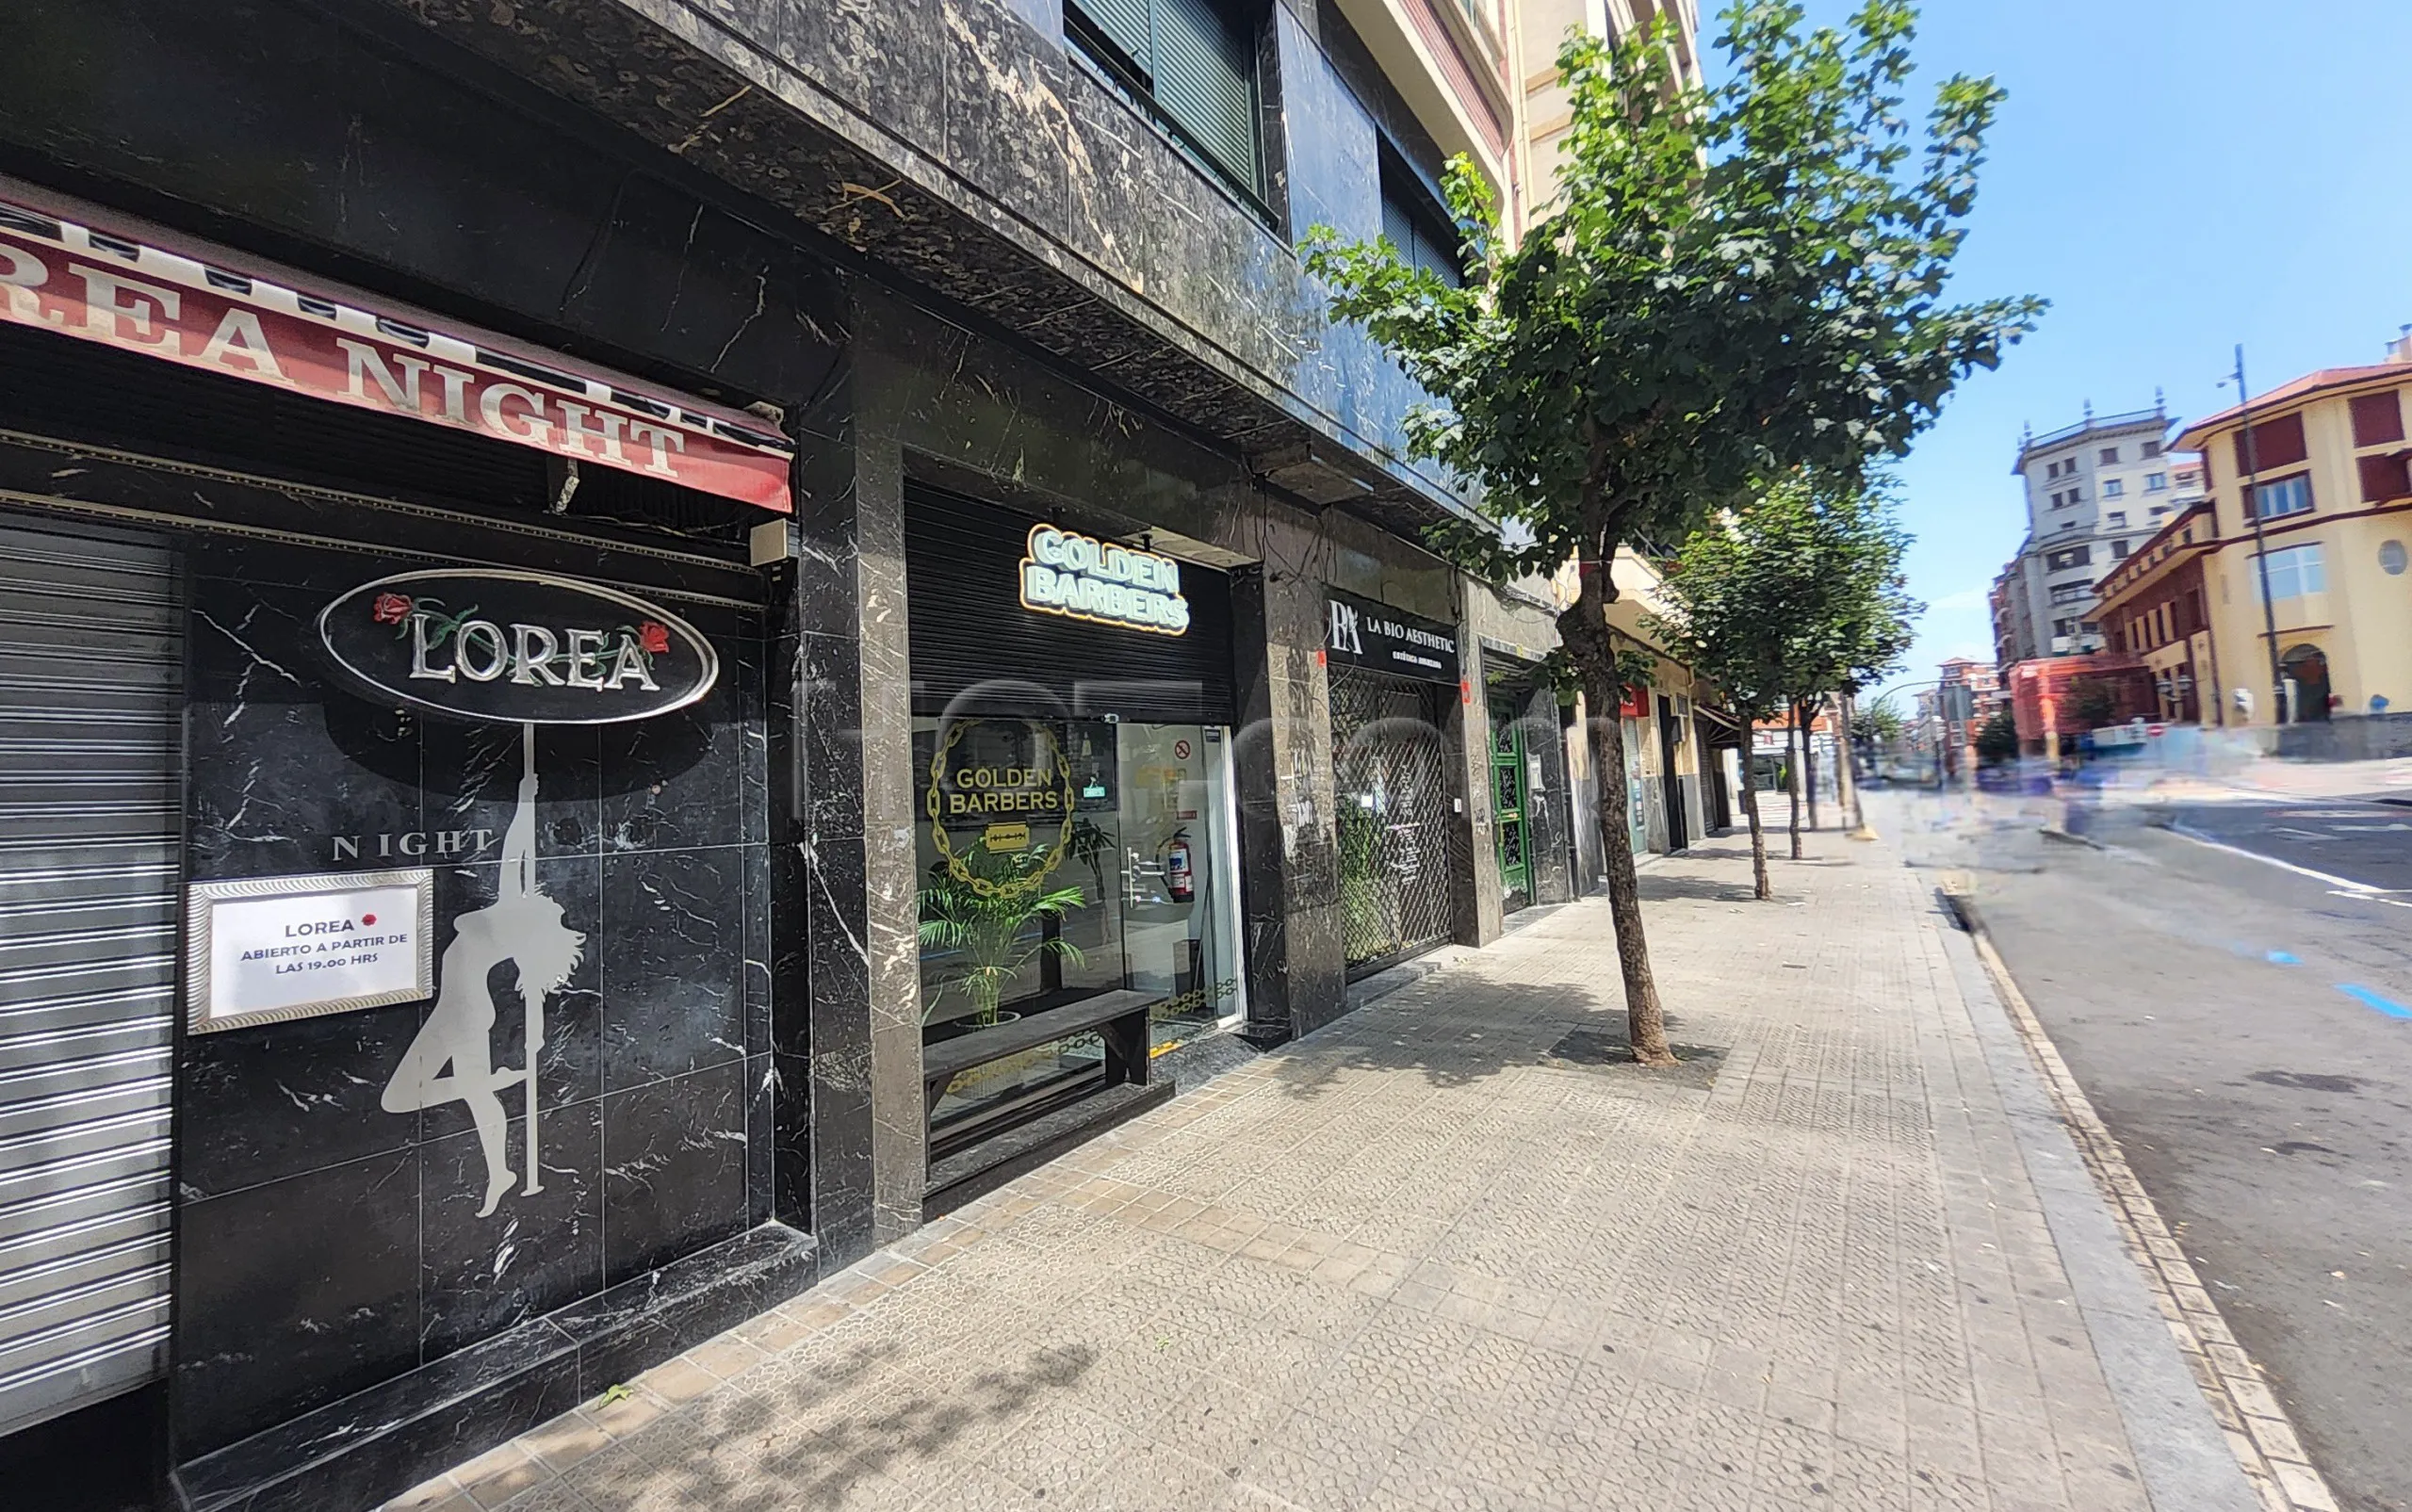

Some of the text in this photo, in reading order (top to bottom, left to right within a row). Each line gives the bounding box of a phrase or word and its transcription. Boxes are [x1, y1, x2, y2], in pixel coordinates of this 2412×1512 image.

[336, 337, 685, 478] NIGHT
[1035, 530, 1180, 593] GOLDEN
[1026, 565, 1190, 627] BARBERS
[1366, 616, 1456, 654] LA BIO AESTHETIC
[409, 613, 660, 691] LOREA
[956, 768, 1052, 789] GOLDEN
[949, 790, 1058, 814] BARBERS
[285, 919, 354, 937] LOREA
[240, 934, 408, 961] ABIERTO A PARTIR DE
[275, 953, 379, 974] LAS 19.00 HRS
